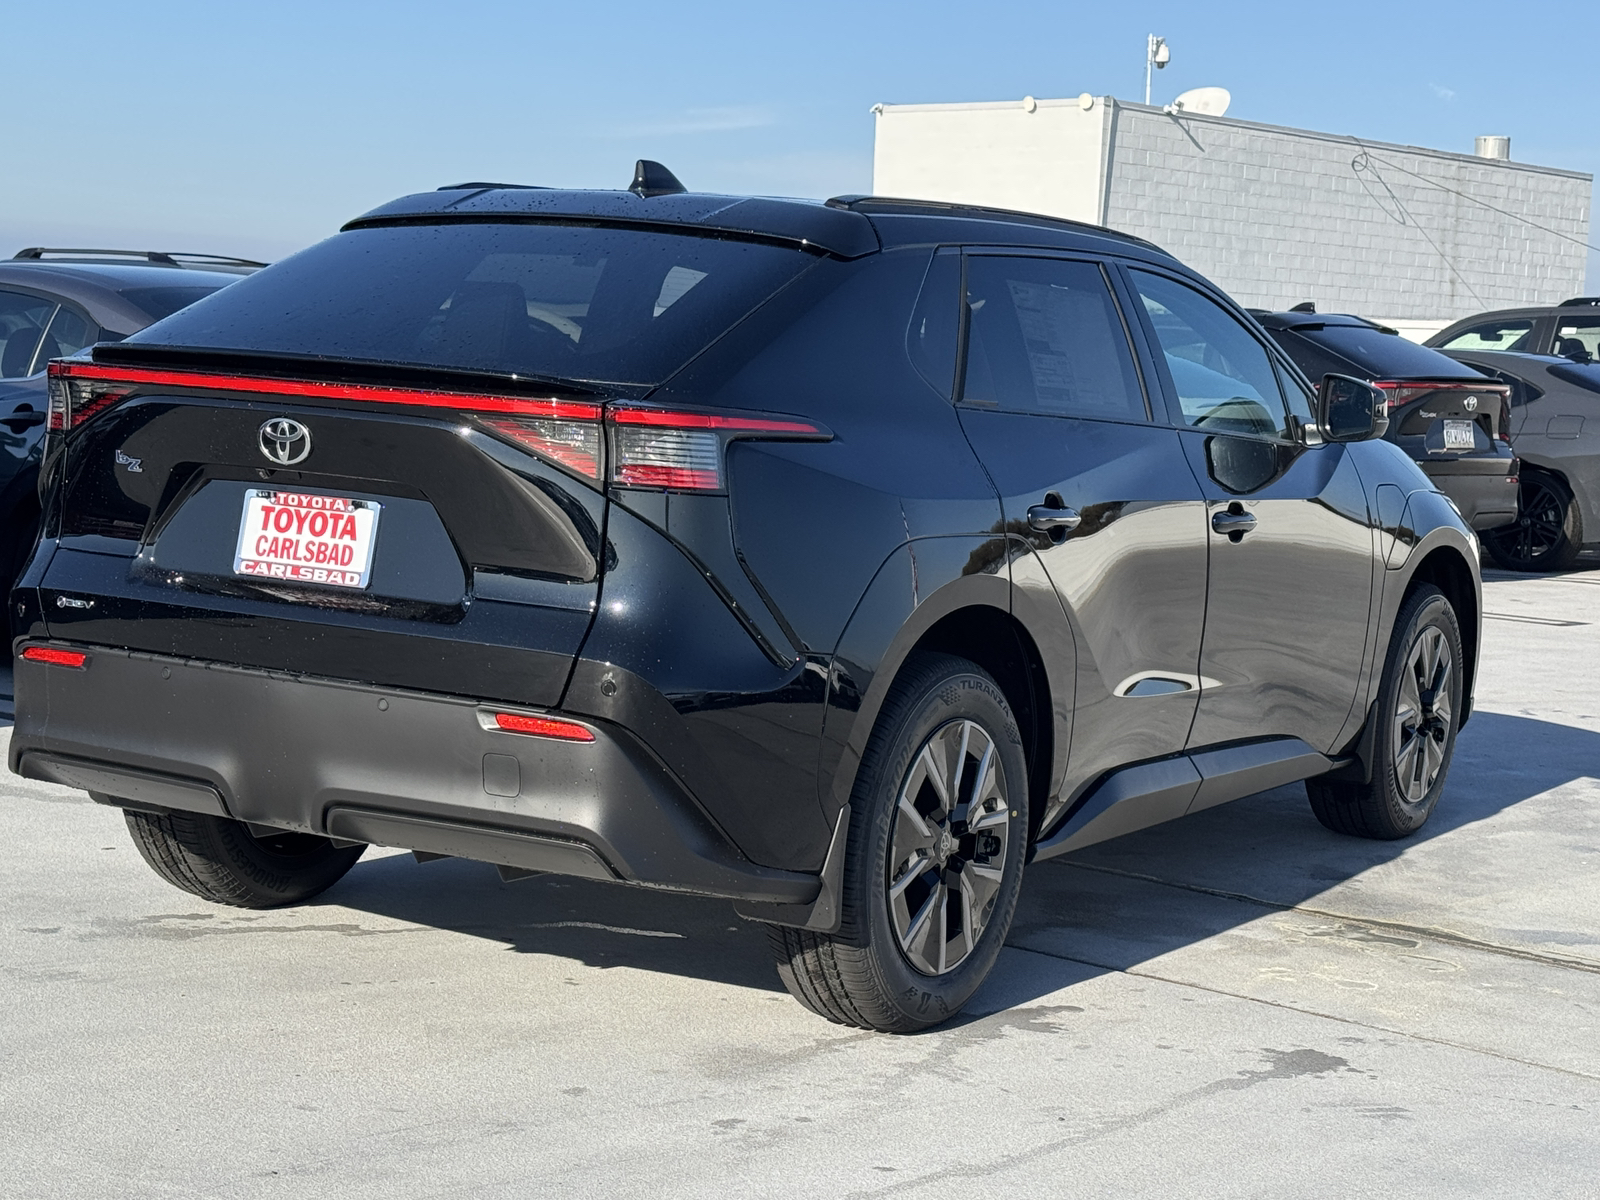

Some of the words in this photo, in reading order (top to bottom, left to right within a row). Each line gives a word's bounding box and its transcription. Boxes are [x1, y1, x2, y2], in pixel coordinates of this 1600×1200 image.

[278, 493, 345, 511] TOYOTA
[261, 505, 357, 541] TOYOTA
[255, 535, 354, 567] CARLSBAD
[240, 561, 361, 586] CARLSBAD
[960, 679, 1011, 718] TURANZA
